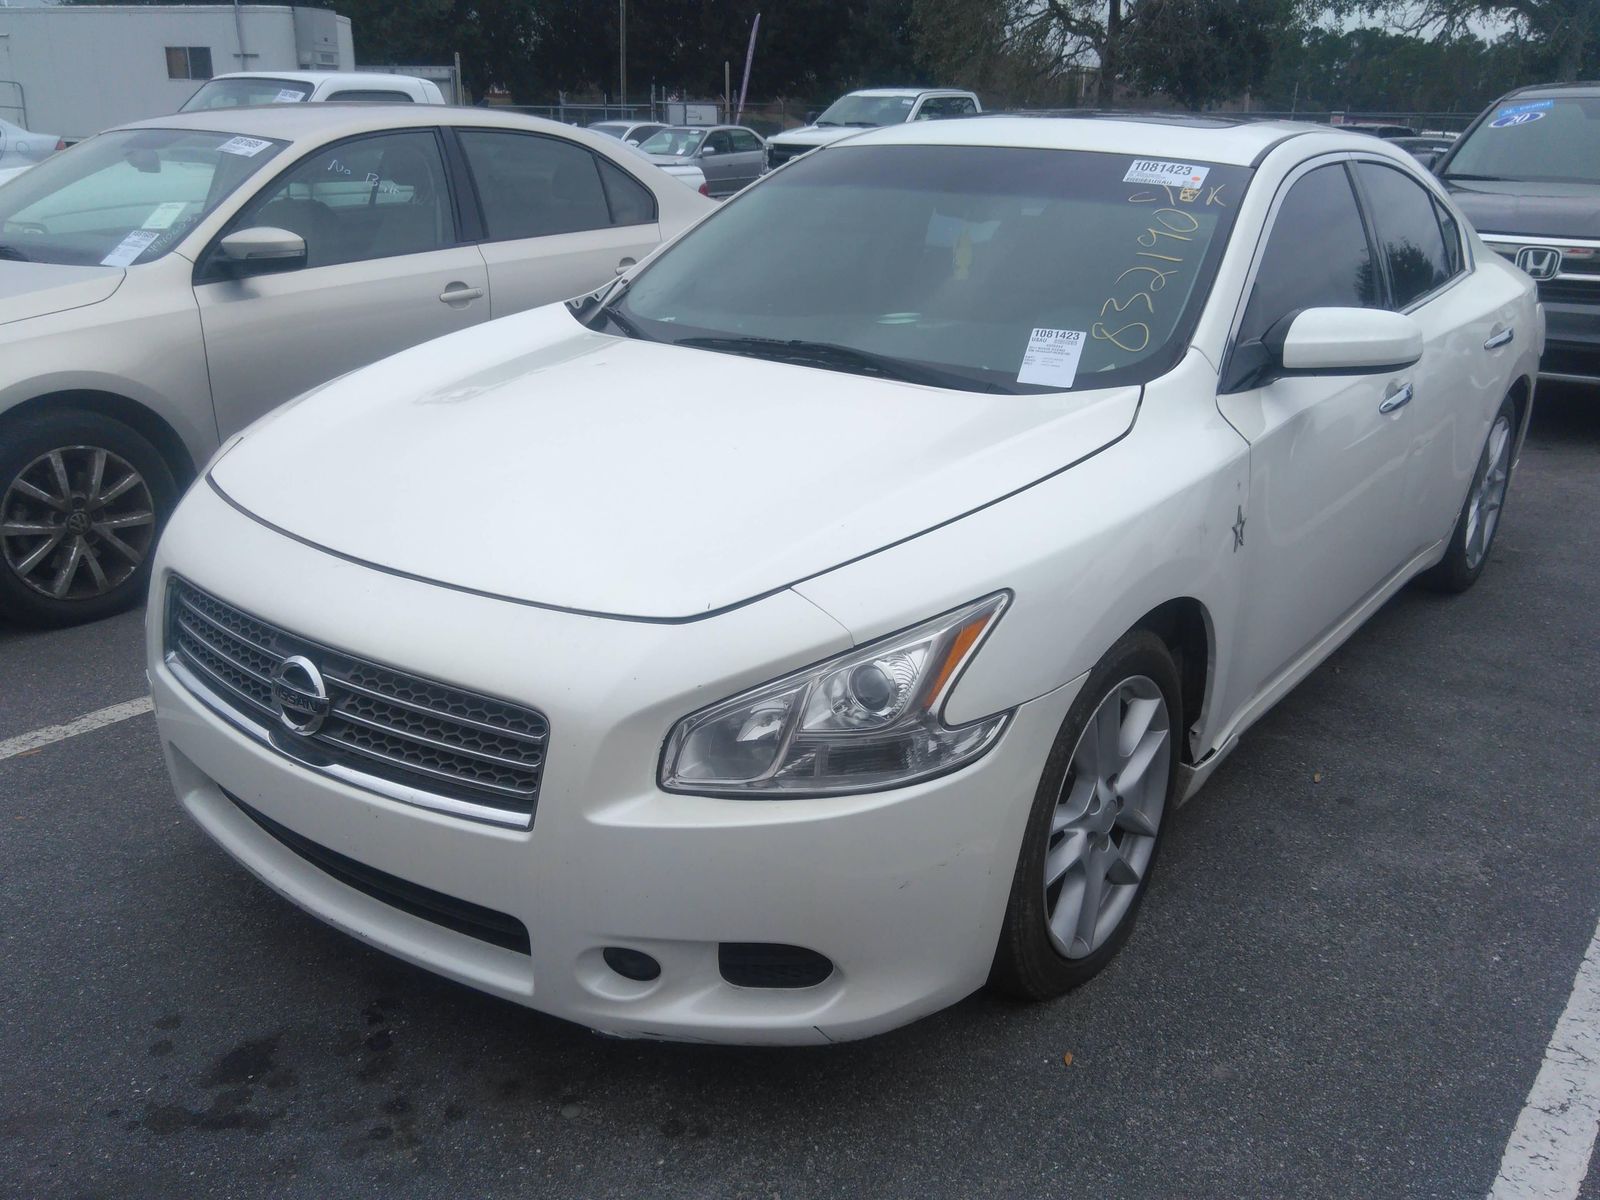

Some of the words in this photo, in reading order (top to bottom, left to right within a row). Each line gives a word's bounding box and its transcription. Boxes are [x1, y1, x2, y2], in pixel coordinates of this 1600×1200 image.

[1134, 161, 1193, 176] 1081423
[1092, 208, 1199, 352] 832190
[1034, 329, 1080, 341] 1081423
[272, 687, 317, 713] NISSAN
